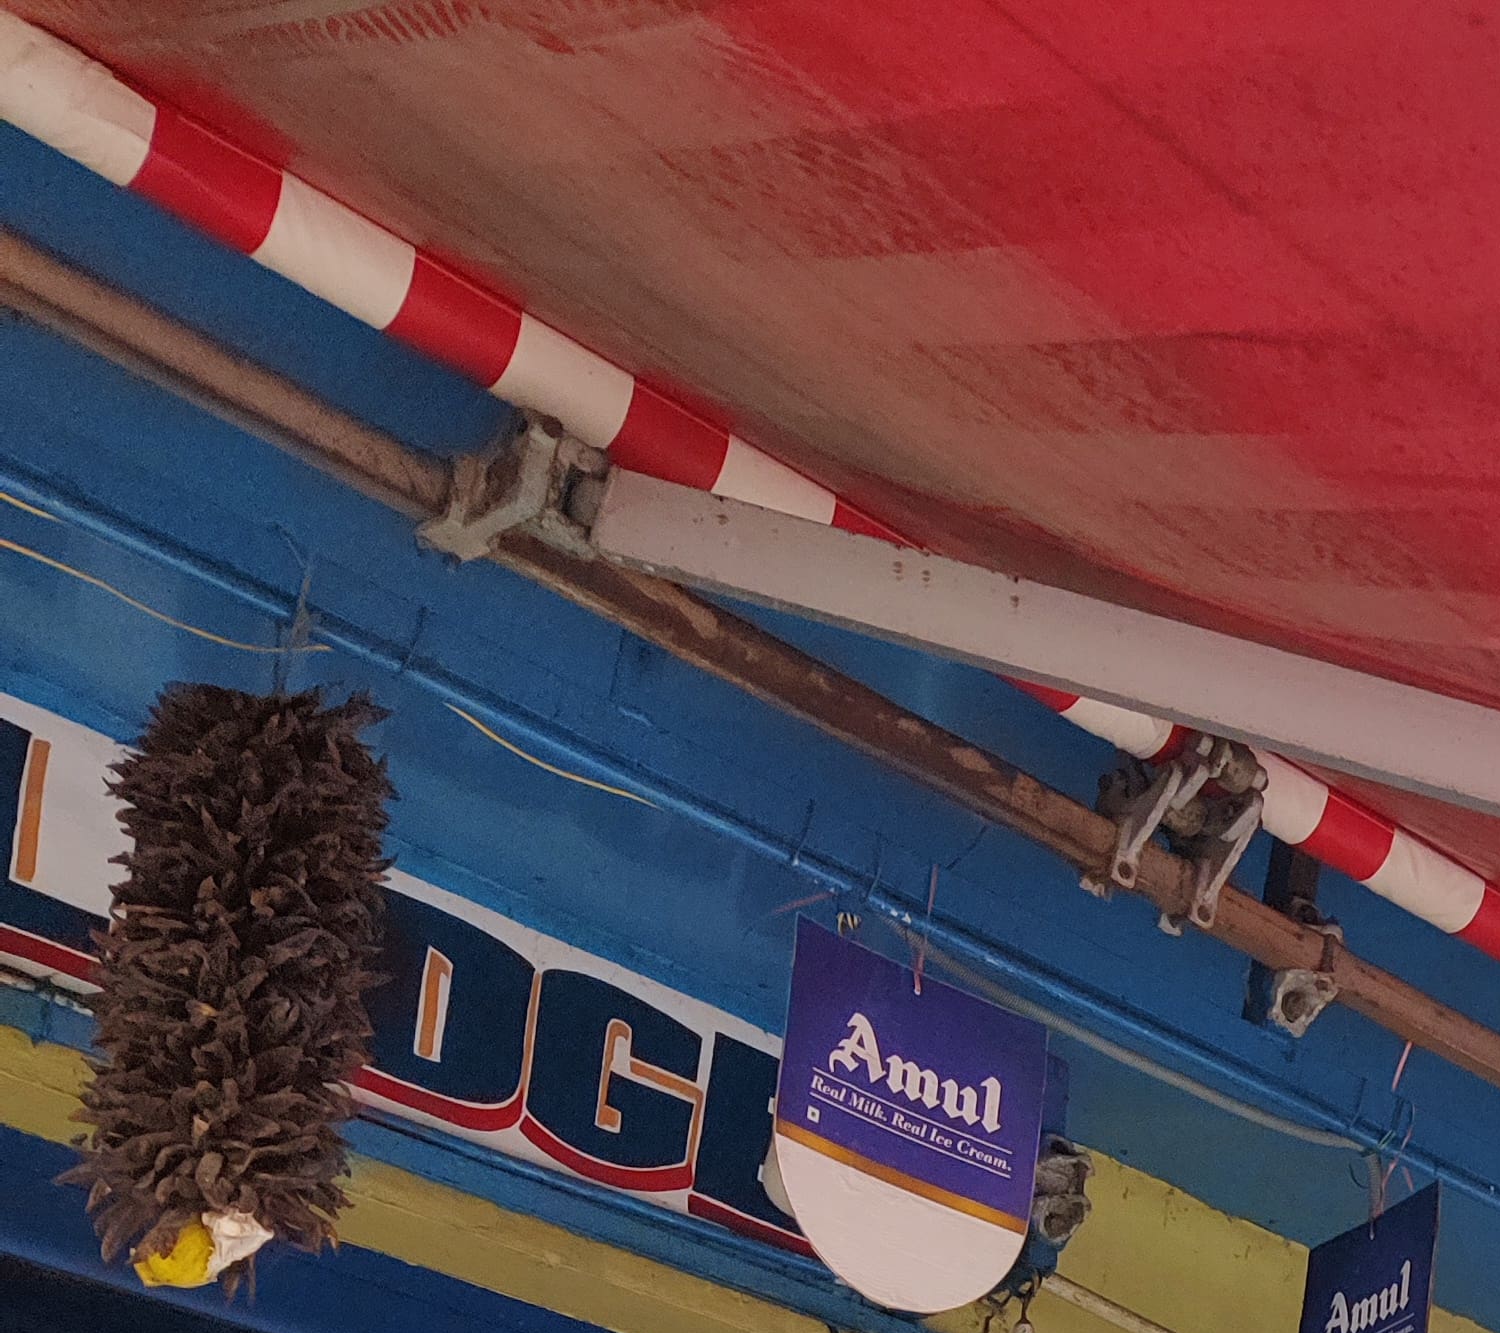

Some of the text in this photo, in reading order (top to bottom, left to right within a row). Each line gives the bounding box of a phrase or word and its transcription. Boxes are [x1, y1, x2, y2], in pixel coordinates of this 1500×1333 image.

[811, 1075, 1012, 1171] Real Milk. Real Ice Cream.
[829, 1012, 1001, 1134] Amul
